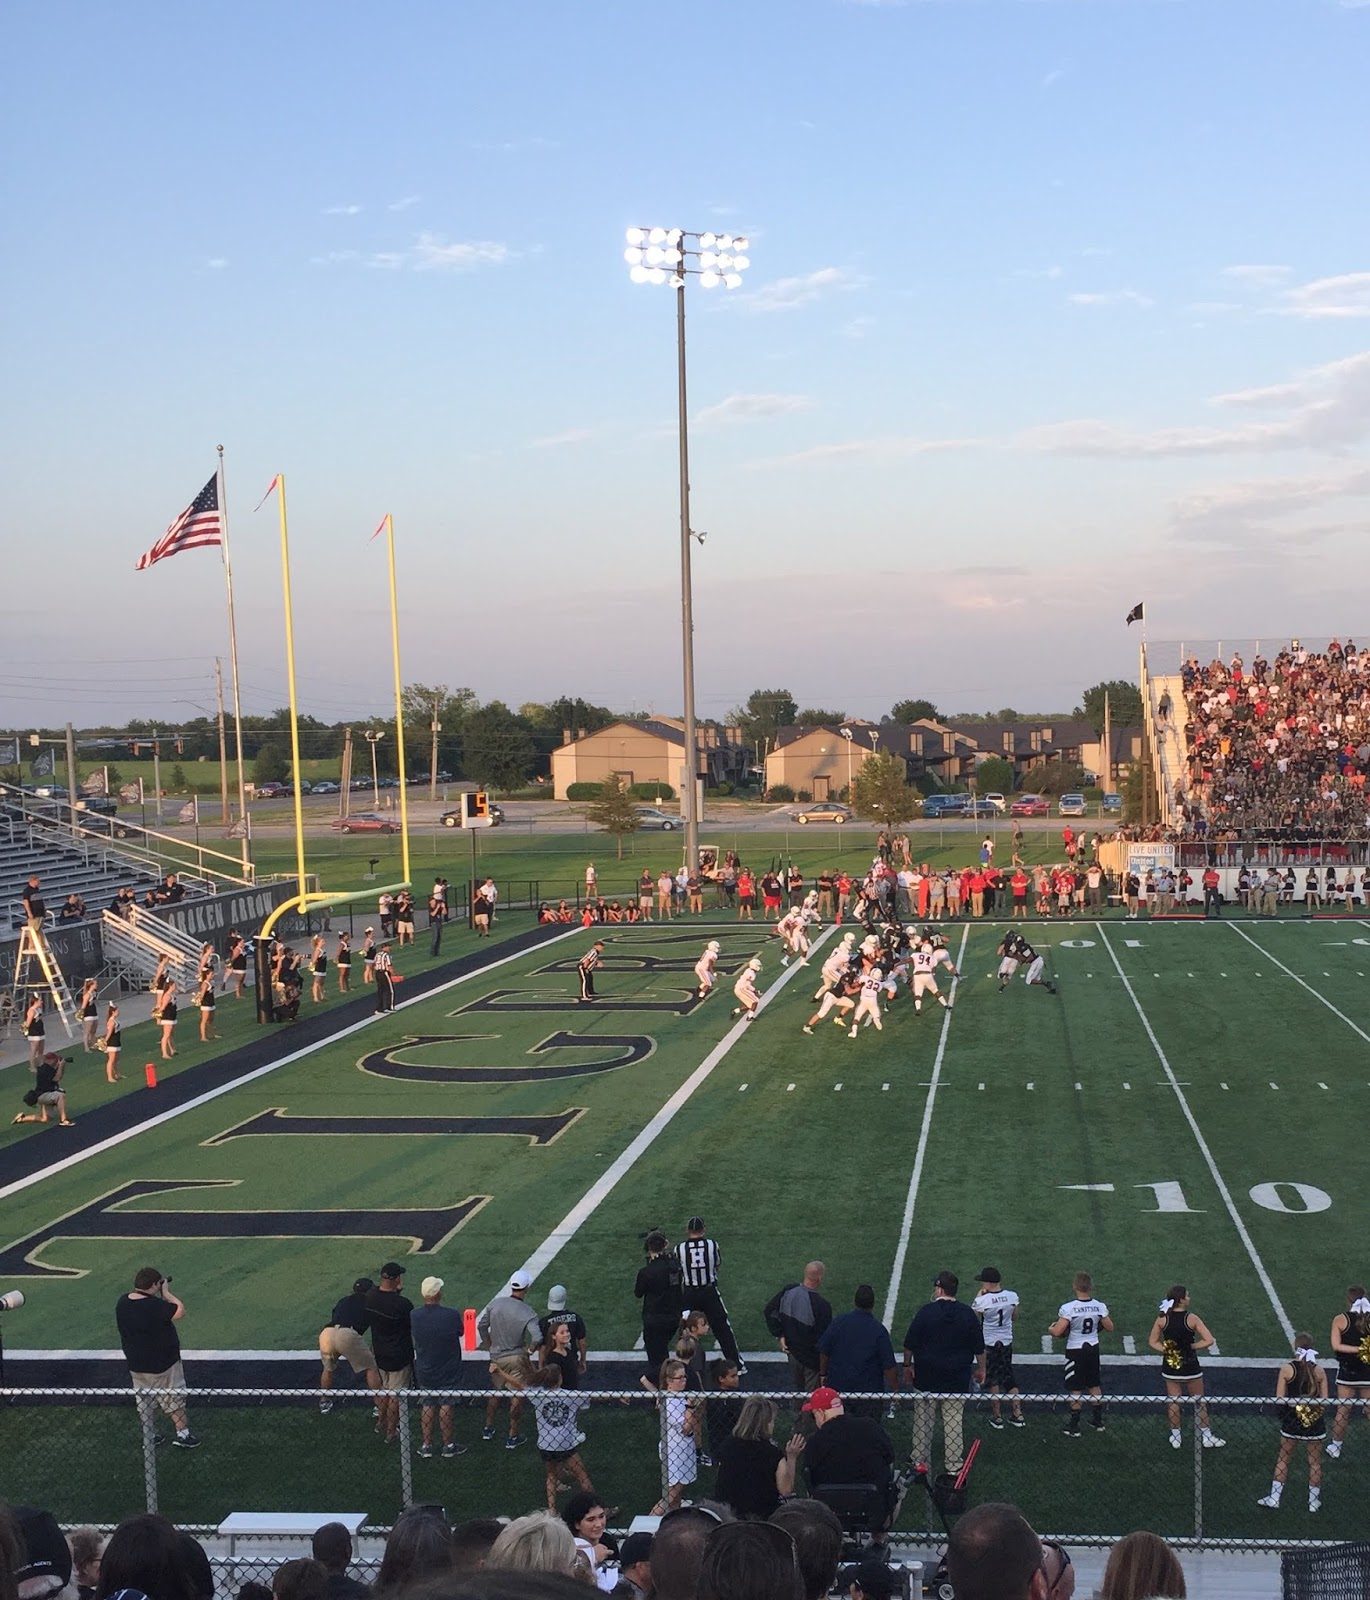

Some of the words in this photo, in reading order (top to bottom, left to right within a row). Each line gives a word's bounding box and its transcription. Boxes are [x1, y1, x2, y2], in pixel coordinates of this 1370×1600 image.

[476, 792, 488, 817] 5
[1129, 845, 1145, 854] LIVE
[1147, 845, 1174, 854] UNITED
[1131, 857, 1154, 865] United
[231, 891, 273, 925] ARROW
[918, 954, 931, 966] 94
[866, 979, 880, 991] 32
[689, 1248, 706, 1268] H
[547, 1313, 576, 1325] TIGERS
[997, 1309, 1004, 1327] 1
